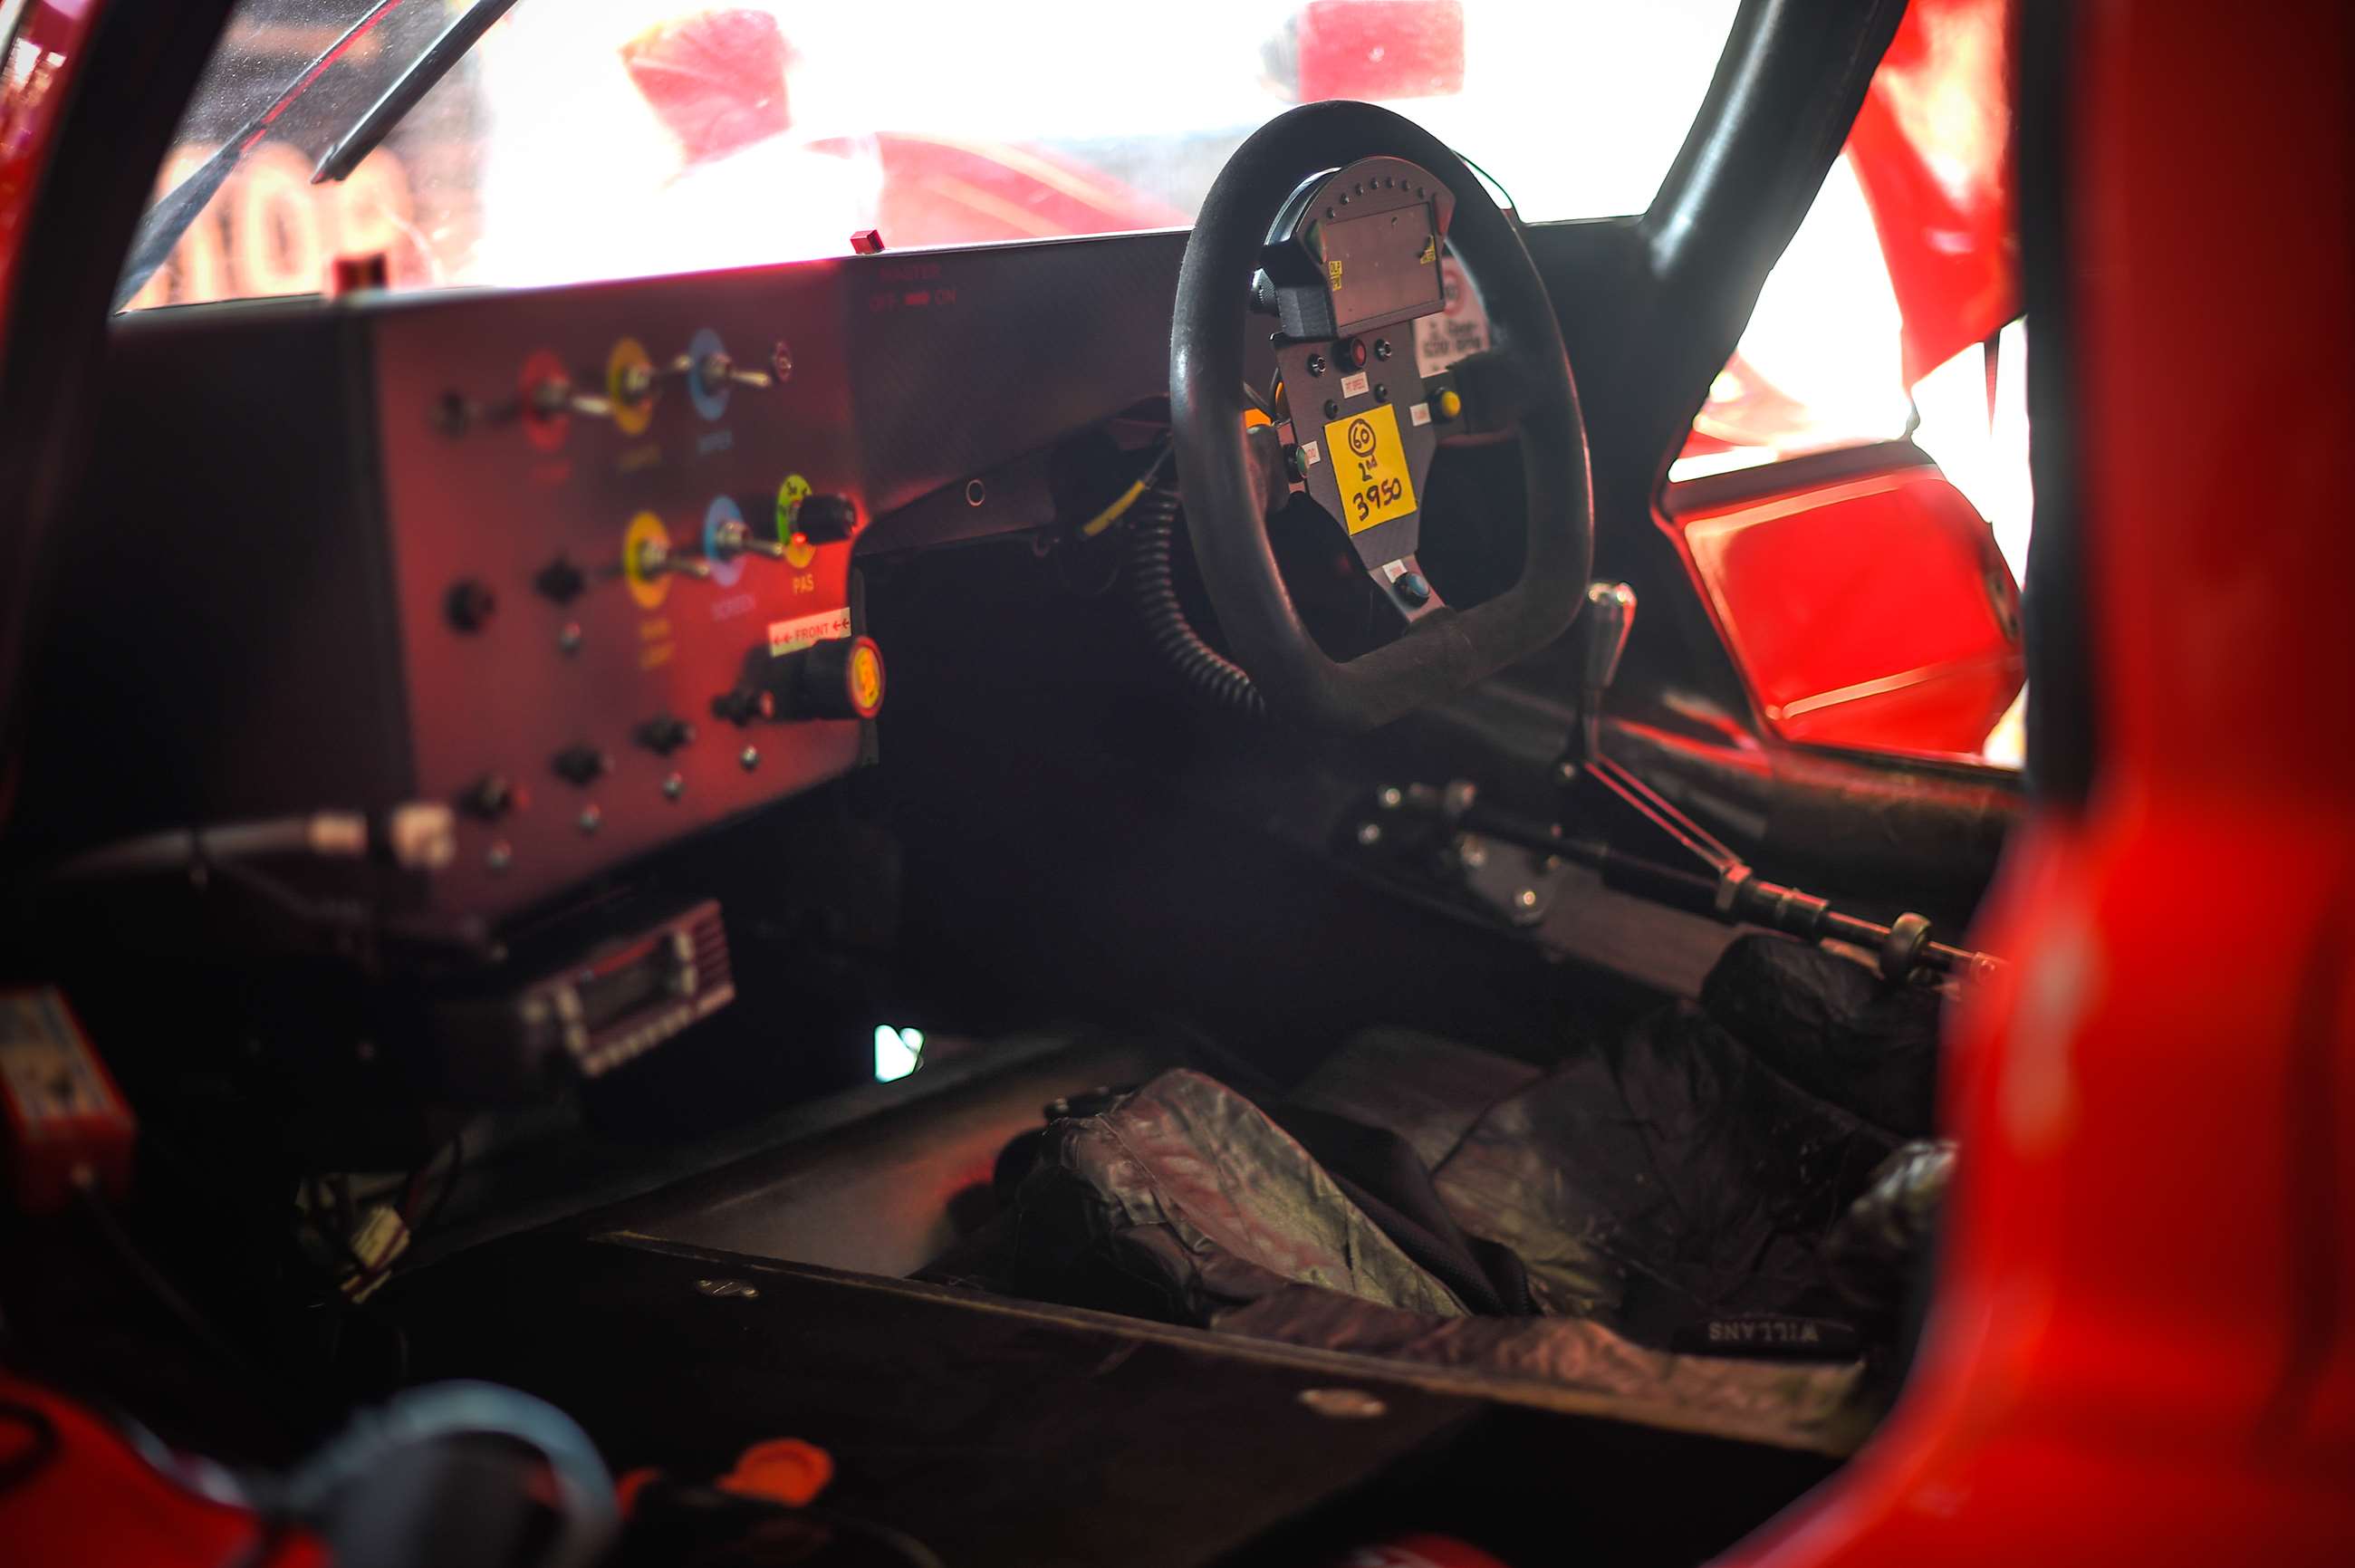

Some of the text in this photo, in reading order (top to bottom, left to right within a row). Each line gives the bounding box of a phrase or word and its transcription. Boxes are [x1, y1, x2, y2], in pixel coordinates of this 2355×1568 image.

[1352, 477, 1403, 522] 3950
[793, 573, 814, 593] PAS
[794, 622, 830, 641] FRONT
[1708, 1321, 1820, 1342] WILLANS
